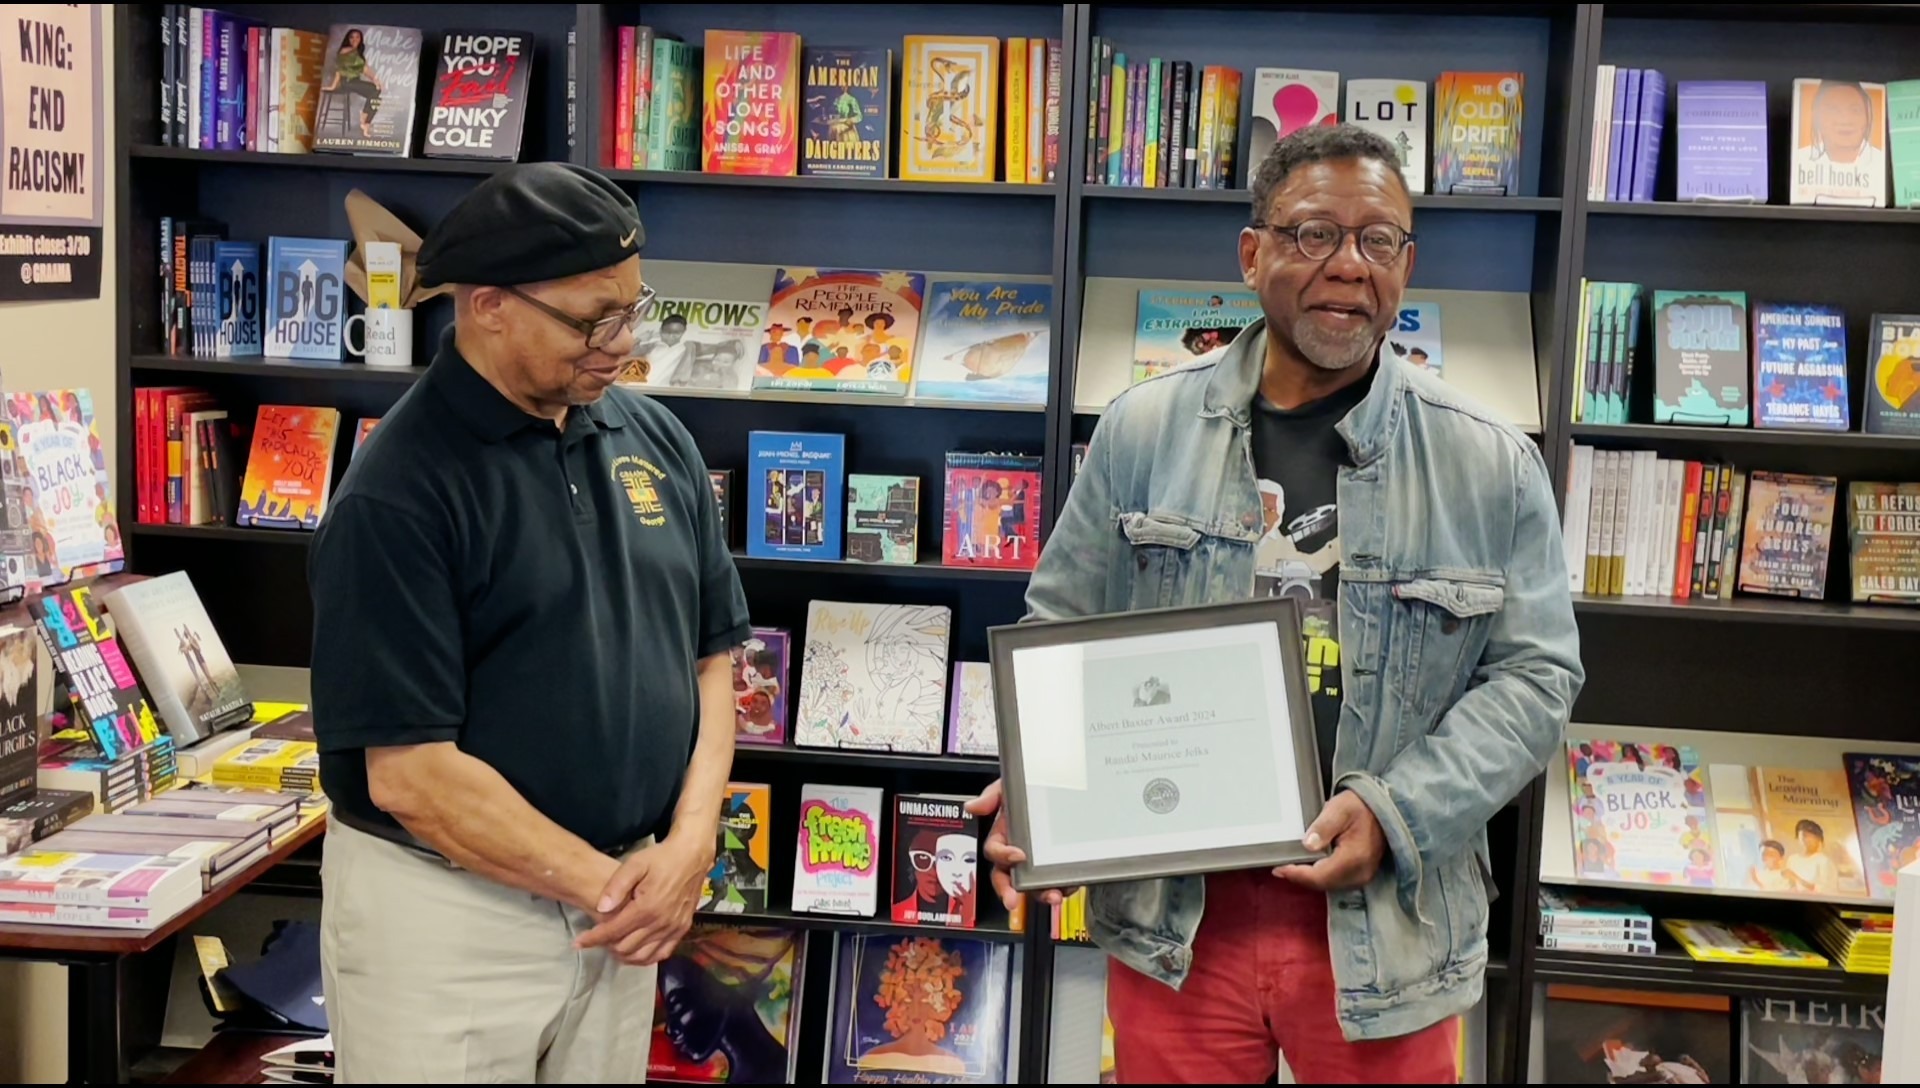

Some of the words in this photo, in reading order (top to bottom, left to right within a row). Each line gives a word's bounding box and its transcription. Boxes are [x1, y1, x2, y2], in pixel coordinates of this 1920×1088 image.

[18, 18, 72, 70] KING:
[364, 28, 415, 48] Make
[444, 35, 451, 53] I
[455, 36, 522, 56] HOPE
[365, 47, 418, 71] Money
[724, 45, 764, 60] LIFE
[444, 56, 496, 76] YOU
[738, 66, 776, 80] AND
[808, 64, 878, 87] AMERICAN
[1049, 55, 1060, 97] DESTROYER
[374, 66, 415, 89] Move
[716, 83, 782, 99] OTHER
[1472, 85, 1493, 95] THE
[29, 86, 65, 132] END
[432, 106, 508, 128] PINKY
[728, 102, 775, 118] LOVE
[1356, 101, 1417, 121] LOT
[1460, 102, 1504, 119] OLD
[1685, 110, 1759, 118] communion
[714, 121, 781, 137] SONGS
[1048, 106, 1059, 136] WORLDS
[317, 138, 354, 146] LAUREN
[356, 140, 400, 148] SIMMONS
[428, 127, 494, 148] COLE
[1202, 125, 1213, 152] DRIFT
[1452, 125, 1509, 143] DRIFT
[714, 142, 750, 154] ANISSA
[754, 144, 783, 155] GRAY
[805, 138, 880, 161] DAUGHTERS
[9, 146, 84, 195] RACISM!
[1798, 164, 1824, 185] bell
[1829, 166, 1869, 188] hooks
[160, 220, 169, 248] LEVEL
[175, 235, 187, 292] TRACTION
[220, 268, 256, 320] BIG
[277, 268, 338, 320] BIG
[814, 290, 878, 302] PEOPLE
[950, 288, 980, 301] You
[986, 286, 1018, 300] Are
[644, 299, 760, 329] ORNROWS
[796, 298, 893, 313] REMEMBER
[959, 303, 989, 319] My
[996, 301, 1045, 316] Pride
[1667, 304, 1733, 332] SOUL
[1760, 312, 1802, 326] AMERICAN
[1804, 315, 1841, 328] SONNETS
[220, 321, 258, 346] HOUSE
[275, 321, 336, 346] HOUSE
[366, 326, 395, 340] Read
[1668, 328, 1740, 351] CULTURE
[1782, 338, 1796, 350] MY
[1797, 338, 1822, 351] PAST
[1761, 361, 1796, 376] FUTURE
[1797, 362, 1844, 377] ASSASSIN
[261, 410, 285, 427] LET
[1766, 402, 1810, 416] TERRANCE
[1812, 404, 1840, 418] HAYES
[260, 438, 322, 470] RADICALIZE
[37, 453, 87, 492] BLACK
[283, 459, 316, 484] YOU
[52, 482, 84, 515] JOY
[1856, 494, 1876, 510] WE
[1774, 502, 1809, 517] FOUR
[1756, 518, 1823, 535] HUNDRED
[1858, 515, 1874, 530] TO
[956, 534, 1026, 560] ART
[1764, 538, 1810, 553] SOULS
[1860, 575, 1895, 590] CALEB
[1089, 722, 1119, 733] Albert
[1122, 718, 1154, 729] Baxter
[1157, 713, 1190, 725] Award
[1193, 710, 1216, 721] 2024
[1132, 740, 1169, 750] Presented
[1104, 755, 1138, 766] Randal
[1141, 751, 1181, 762] Maurice
[1185, 746, 1209, 757] Jelks
[1618, 773, 1644, 783] YEAR
[1769, 782, 1818, 796] Leaving
[900, 801, 959, 819] UNMASKING
[1607, 791, 1675, 812] BLACK
[1784, 794, 1838, 808] Morning
[1620, 811, 1666, 831] JOY
[904, 911, 916, 920] JOY
[959, 1023, 977, 1034] AM
